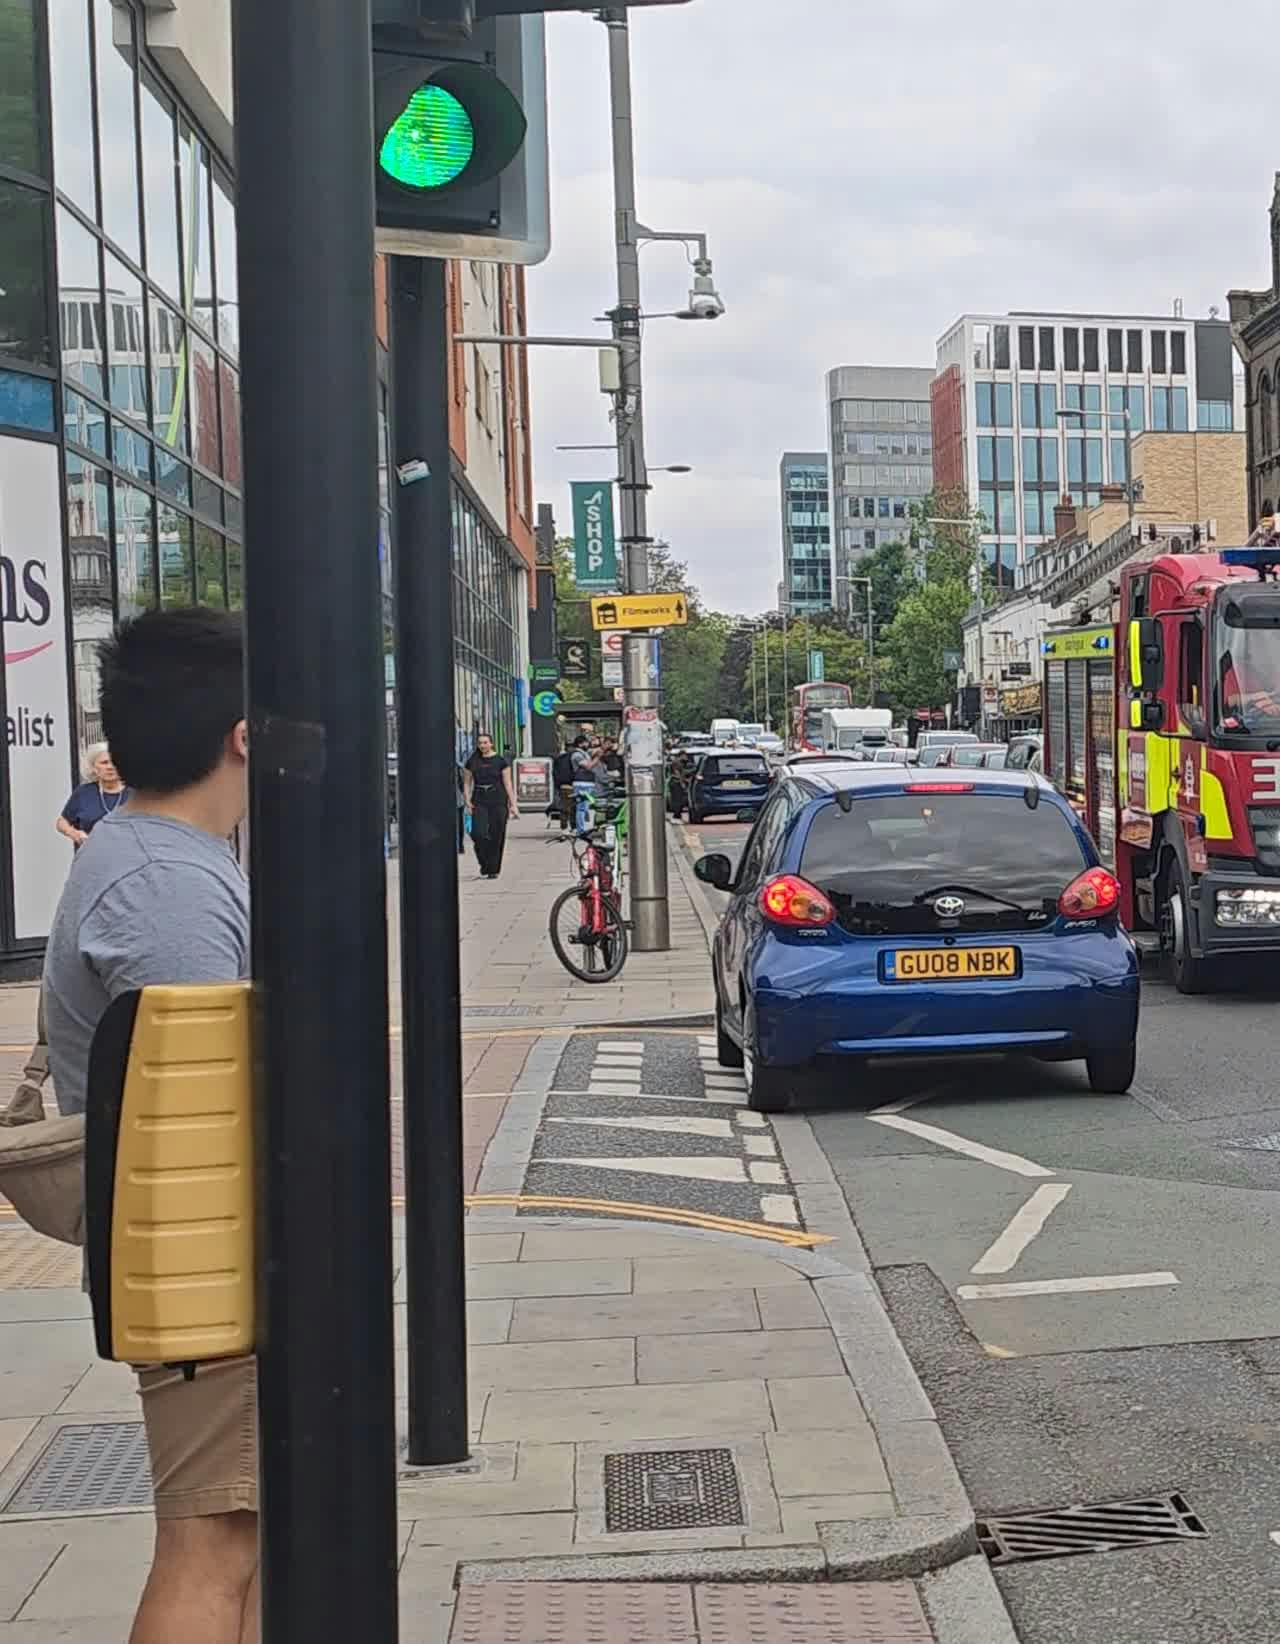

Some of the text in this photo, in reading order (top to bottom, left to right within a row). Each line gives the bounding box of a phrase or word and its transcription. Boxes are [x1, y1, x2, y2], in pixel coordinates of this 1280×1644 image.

[586, 506, 603, 572] SHOP
[622, 606, 671, 616] Filmworks
[797, 929, 829, 937] TOYOTA
[900, 951, 1010, 975] GU08 NBK
